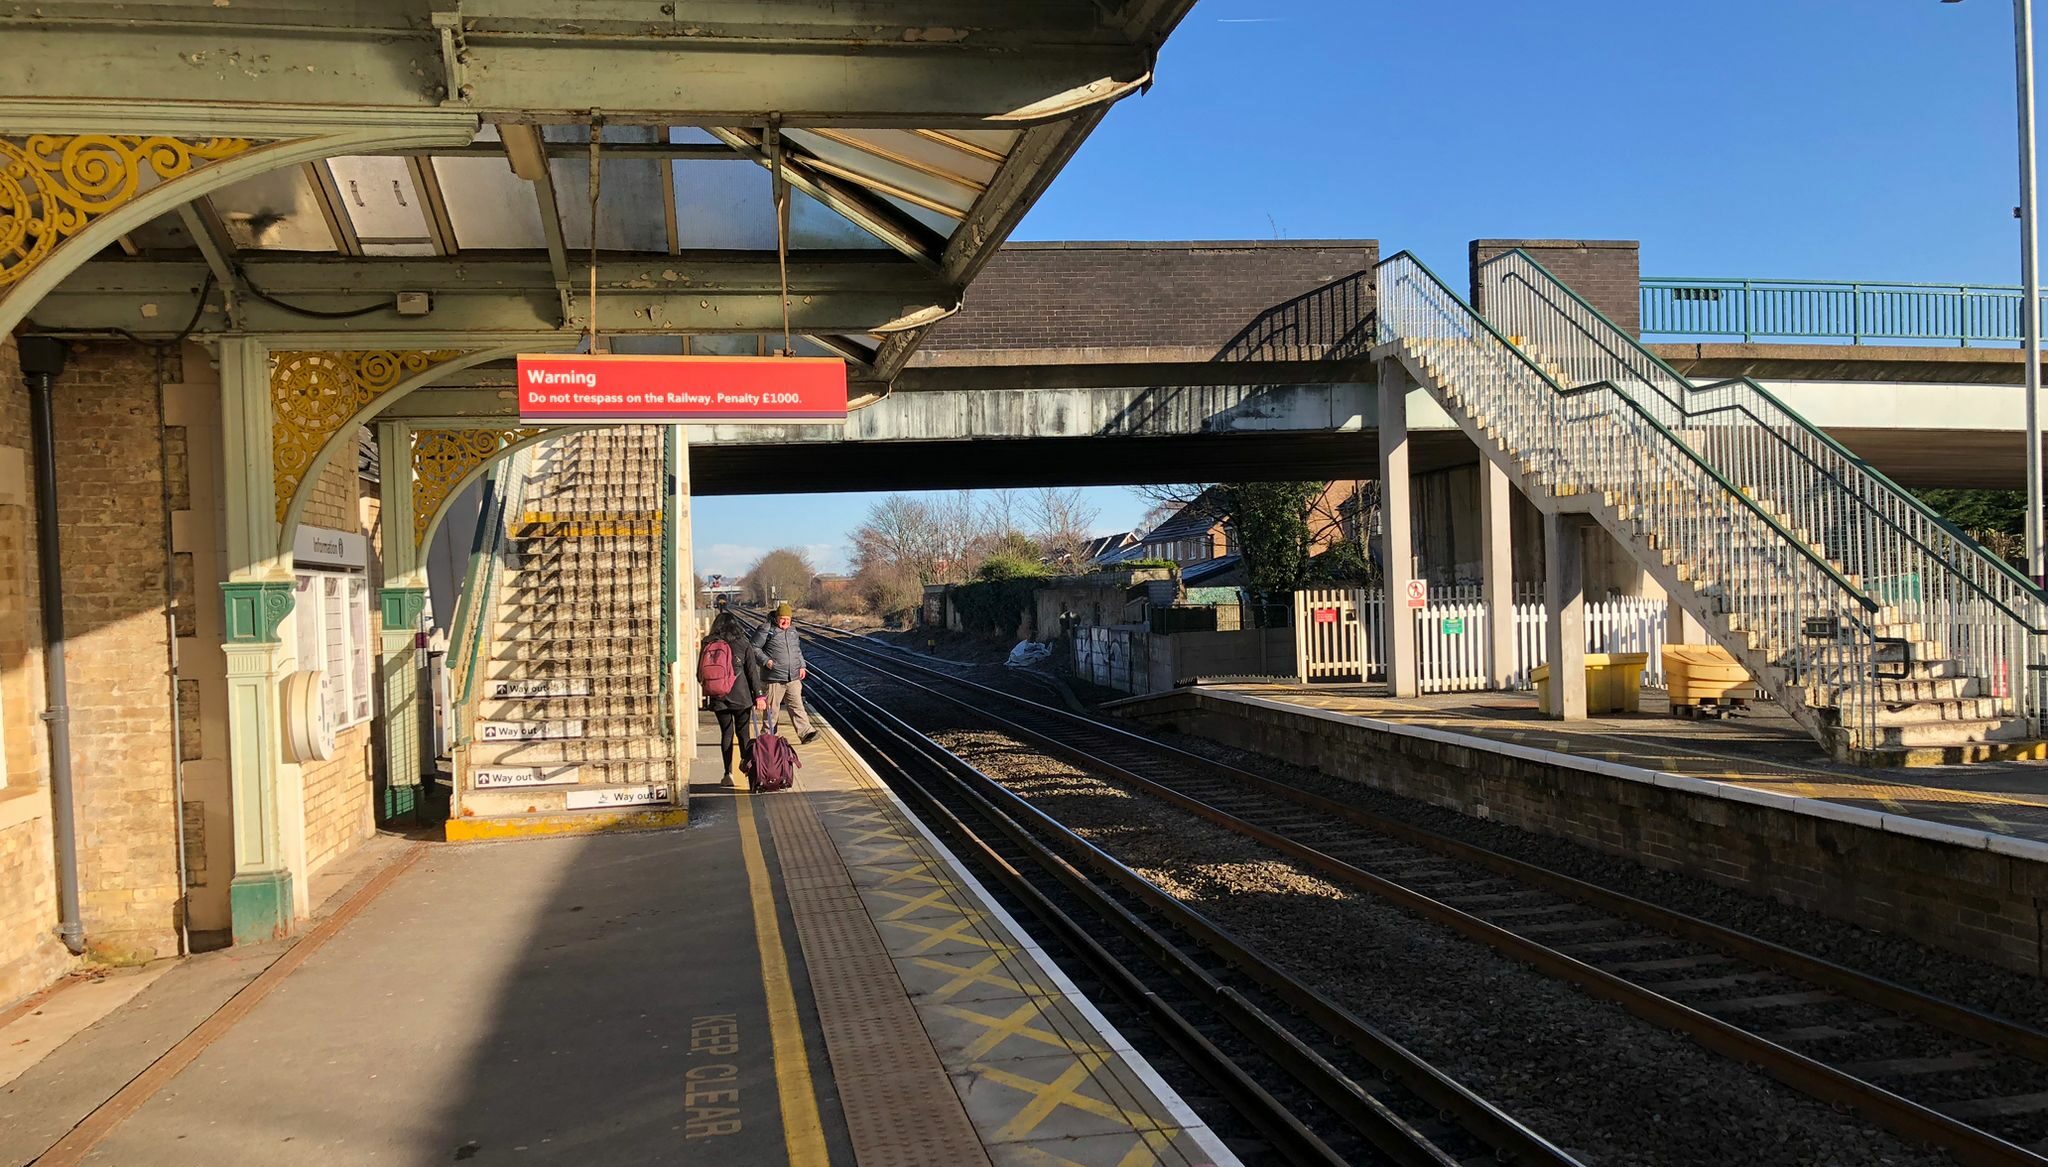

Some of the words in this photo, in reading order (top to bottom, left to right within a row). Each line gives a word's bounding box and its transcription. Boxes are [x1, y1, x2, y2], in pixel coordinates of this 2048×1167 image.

[527, 369, 596, 387] Warning
[528, 392, 547, 404] Do
[550, 392, 571, 404] not
[573, 392, 624, 406] trespass
[626, 394, 642, 404] on
[644, 392, 664, 404] the
[667, 392, 715, 406] Railway.
[717, 392, 760, 406] Penalty
[762, 392, 802, 404] £1000.
[313, 536, 338, 555] Information
[509, 684, 529, 694] Way
[531, 684, 547, 693] out
[498, 727, 518, 736] Way
[521, 726, 538, 735] out
[492, 773, 513, 784] Way
[516, 773, 532, 783] out
[614, 792, 634, 803] Way
[637, 791, 655, 801] out
[691, 1013, 738, 1055] KEEP
[685, 1064, 741, 1139] CLEAR
